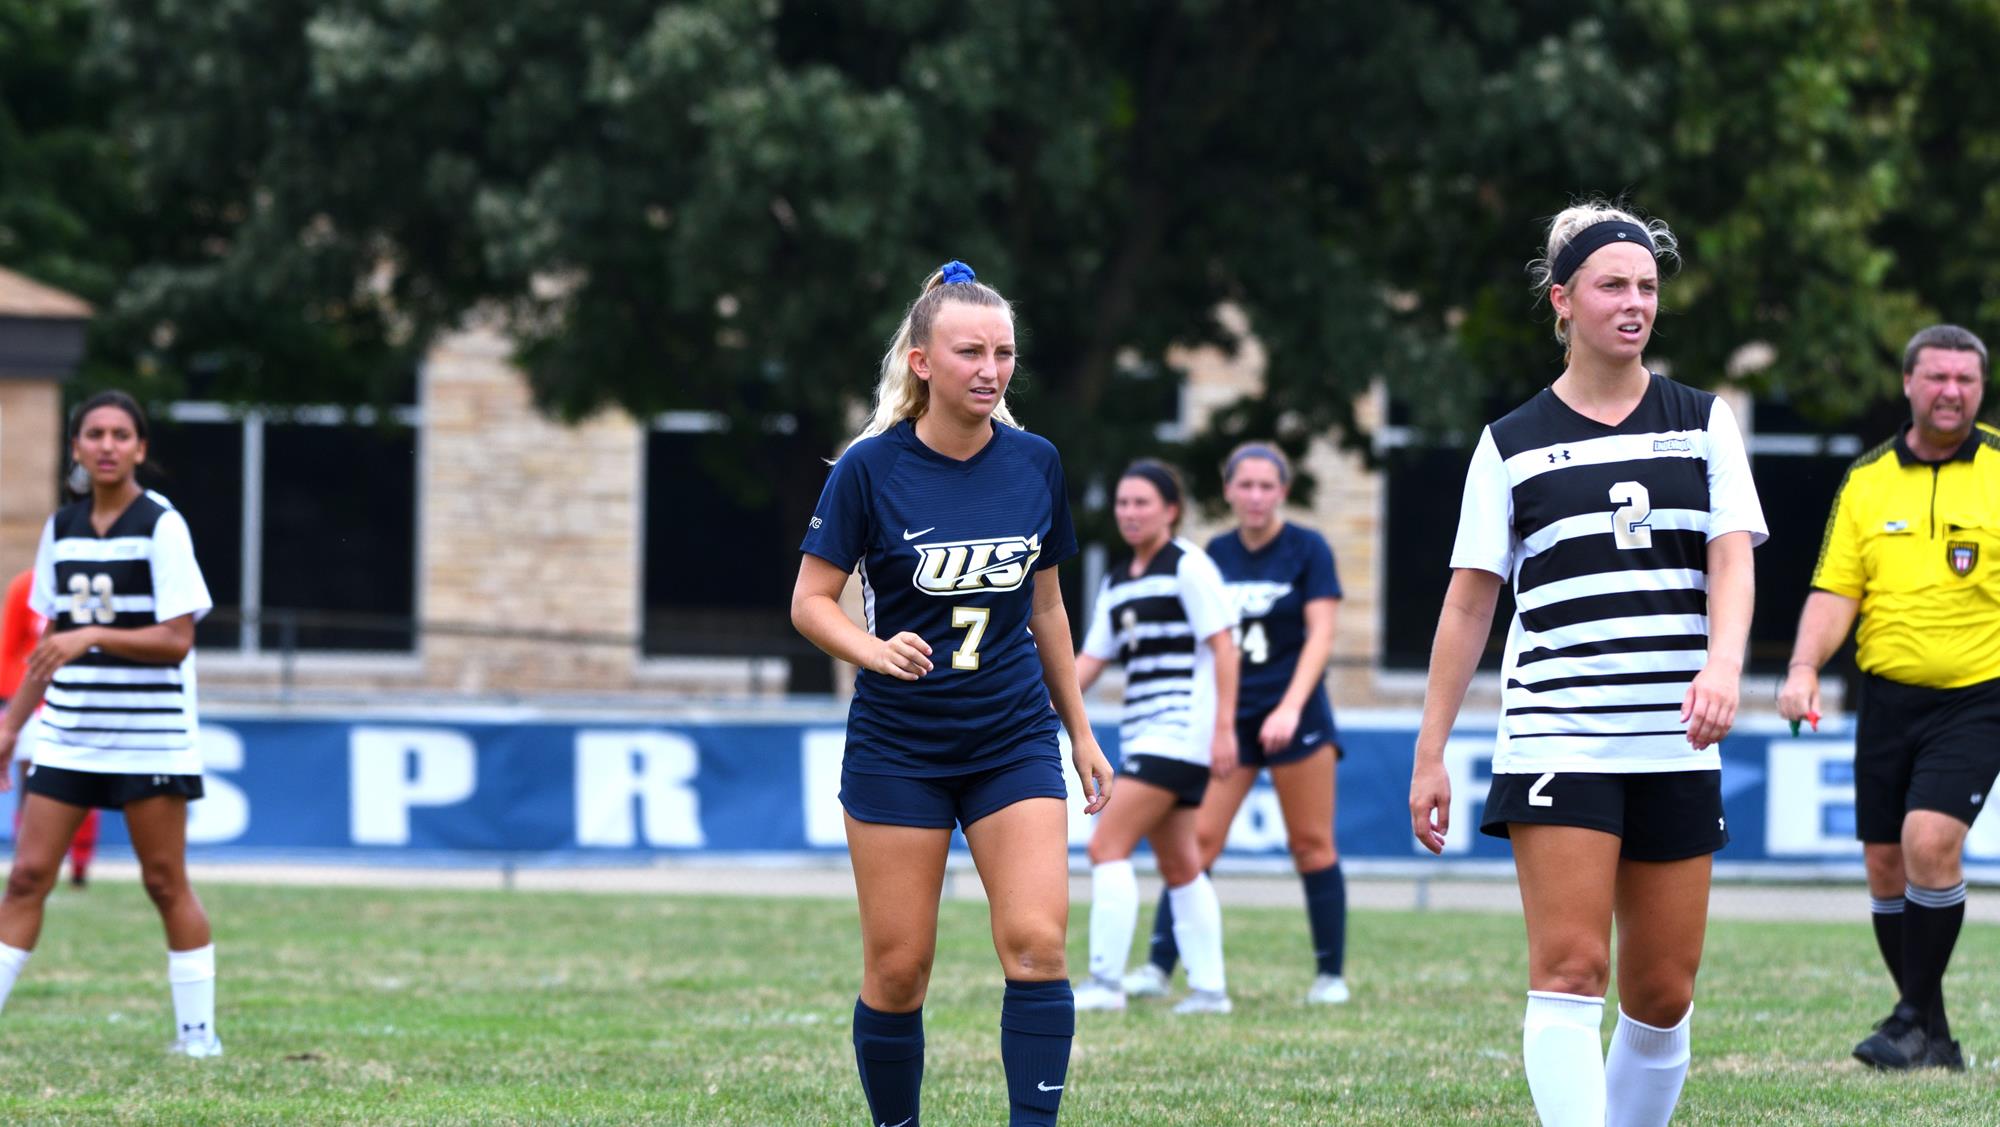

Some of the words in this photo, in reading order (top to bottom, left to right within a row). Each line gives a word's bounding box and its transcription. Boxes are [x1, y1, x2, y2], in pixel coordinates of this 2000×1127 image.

[1608, 481, 1653, 550] 2
[914, 535, 1040, 595] UIS
[68, 573, 116, 625] 23
[951, 606, 990, 671] 7
